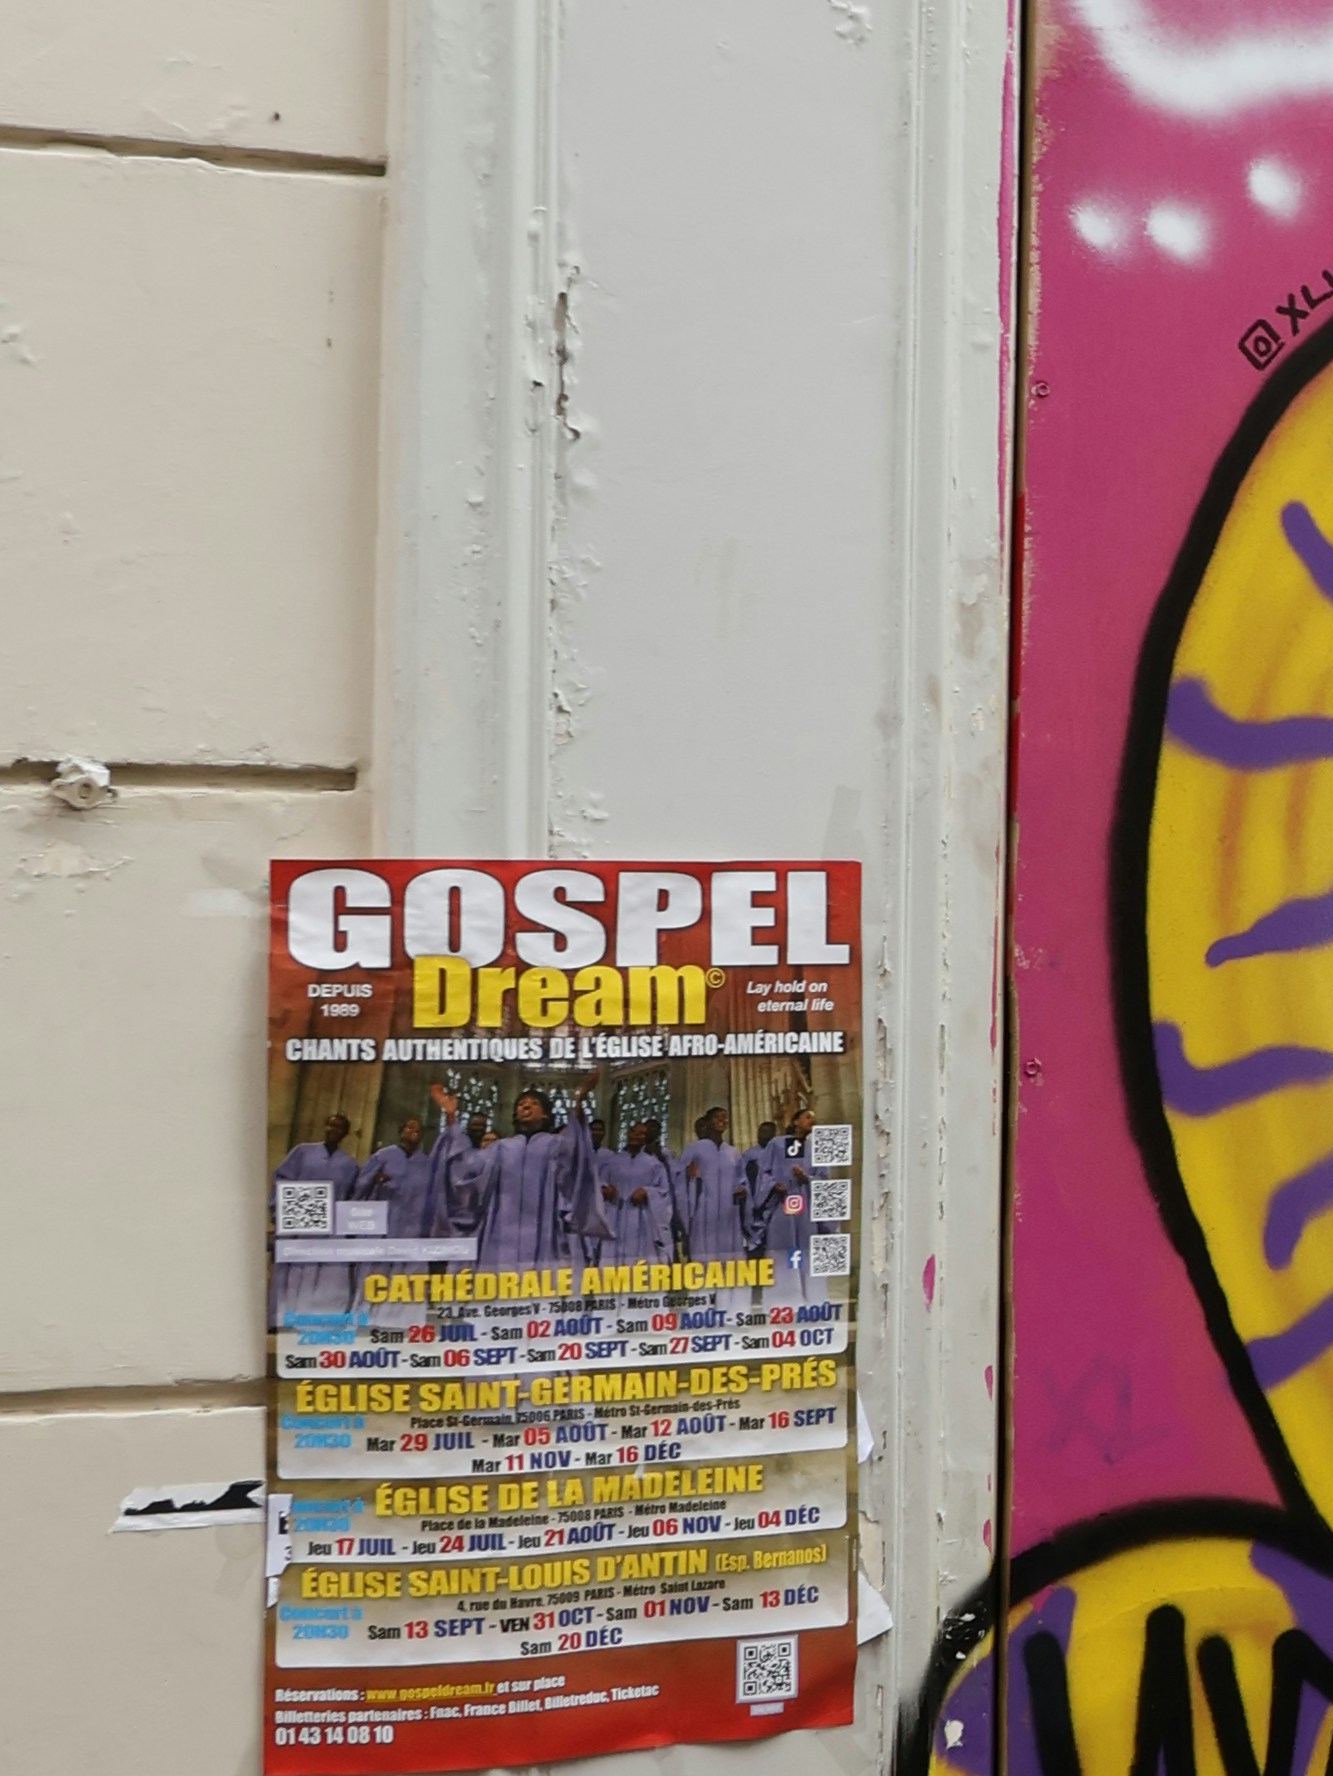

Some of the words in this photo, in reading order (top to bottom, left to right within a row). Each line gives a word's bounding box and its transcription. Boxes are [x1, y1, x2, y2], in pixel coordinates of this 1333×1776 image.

[287, 867, 851, 971] GOSPEL
[308, 984, 373, 997] DEPUIS
[747, 981, 769, 996] Lay
[774, 980, 805, 993] hold
[809, 982, 827, 993] on
[320, 1004, 360, 1016] 1989
[758, 999, 808, 1012] eternal
[811, 999, 834, 1011] life
[285, 1039, 376, 1061] CHANTS
[382, 1038, 542, 1062] AUTHENTIQUES
[549, 1037, 575, 1059] DE
[582, 1033, 663, 1058] L'ÉGLISE
[668, 1029, 844, 1056] AFRO-AMÉRICAINE
[363, 1267, 573, 1303] CATHÉDRALE
[581, 1259, 775, 1295] AMÉRICAINE
[371, 1329, 404, 1343] Sam
[408, 1325, 435, 1342] 26
[438, 1325, 478, 1342] JUIL
[491, 1327, 522, 1340] Sam
[527, 1321, 550, 1338] 02
[554, 1316, 604, 1336] AOÛT
[617, 1319, 648, 1333] Sam
[652, 1314, 677, 1331] 09
[680, 1308, 726, 1330] AOÛT
[736, 1311, 766, 1326] Sam
[770, 1307, 794, 1324] 23
[797, 1303, 842, 1323] AOÛT
[286, 1354, 317, 1369] Sam
[320, 1351, 346, 1368] 30
[350, 1348, 401, 1368] AOÛT
[410, 1354, 441, 1367] Sam
[444, 1351, 470, 1366] 06
[474, 1347, 517, 1365] SEPT
[527, 1348, 556, 1363] Sam
[557, 1343, 581, 1361] 20
[585, 1340, 628, 1359] SEPT
[639, 1342, 667, 1355] Sam
[670, 1337, 689, 1354] 27
[691, 1335, 732, 1353] SEPT
[742, 1336, 769, 1349] Sam
[772, 1331, 795, 1348] 04
[801, 1328, 834, 1346] OCT
[296, 1380, 411, 1413] ÉGLISE
[419, 1359, 837, 1413] SAINT-GERMAIN-DES-PRÉS
[367, 1438, 397, 1452] Mar
[400, 1434, 427, 1451] 29
[434, 1433, 474, 1451] JUIL
[493, 1434, 519, 1447] Mar
[524, 1427, 550, 1445] 05
[556, 1423, 608, 1443] AOÛT
[621, 1424, 647, 1439] Mar
[651, 1419, 671, 1437] 12
[676, 1414, 726, 1435] AOÛT
[739, 1416, 765, 1430] Mar
[768, 1411, 789, 1429] 16
[794, 1407, 837, 1427] SEPT
[472, 1459, 502, 1473] Mar
[505, 1455, 524, 1471] 11
[530, 1451, 572, 1470] NOV
[585, 1451, 612, 1465] Mar
[616, 1446, 638, 1463] 16
[644, 1442, 681, 1461] DÉC
[375, 1483, 489, 1516] ÉGLISE
[498, 1482, 538, 1510] DE
[546, 1479, 584, 1507] LA
[592, 1465, 763, 1503] MADELEINE
[308, 1541, 332, 1555] Jeu
[336, 1538, 354, 1555] 17
[357, 1538, 396, 1555] JUIL
[412, 1541, 436, 1554] Jeu
[439, 1535, 464, 1552] 24
[469, 1534, 506, 1551] JUIL
[518, 1534, 541, 1548] Jeu
[544, 1529, 565, 1546] 21
[567, 1522, 616, 1544] AOÛT
[627, 1524, 649, 1538] Jeu
[653, 1518, 678, 1536] 06
[683, 1516, 722, 1534] NOV
[734, 1517, 755, 1530] Jeu
[758, 1510, 781, 1528] 04
[785, 1506, 820, 1526] DÉC
[421, 1518, 454, 1532] Place
[457, 1517, 471, 1530] de
[475, 1517, 485, 1529] la
[488, 1513, 549, 1528] Madeleine
[594, 1507, 624, 1519] PARIS
[635, 1502, 666, 1516] Métro
[669, 1499, 726, 1513] Madeleine
[302, 1567, 402, 1599] ÉGLISE
[408, 1559, 590, 1598] SAINT-LOUIS
[597, 1549, 708, 1583] D'ANTIN
[753, 1544, 827, 1569] Bernanos)
[470, 1599, 489, 1611] rue
[492, 1597, 507, 1610] du
[584, 1588, 615, 1601] PARIS
[623, 1583, 655, 1596] Métro
[660, 1581, 689, 1594] Saint
[691, 1578, 725, 1592] Lazare
[368, 1625, 400, 1640] Sam
[404, 1621, 429, 1639] 13
[434, 1618, 485, 1637] SEPT
[500, 1618, 529, 1633] VEN
[533, 1612, 555, 1630] 31
[558, 1607, 595, 1627] OCT
[606, 1607, 637, 1621] Sam
[643, 1601, 665, 1618] 01
[669, 1596, 710, 1615] NOV
[722, 1597, 753, 1611] Sam
[760, 1590, 780, 1608] 13
[784, 1585, 819, 1606] DÉC
[520, 1641, 551, 1655] Sam
[557, 1632, 581, 1651] 20
[585, 1628, 623, 1647] DÉC
[464, 1700, 506, 1717] France
[611, 1684, 660, 1702] Ticketac
[497, 1679, 509, 1693] et
[512, 1679, 531, 1692] sur
[533, 1675, 565, 1691] place
[275, 1727, 296, 1745] 01
[298, 1727, 321, 1745] 43
[325, 1727, 344, 1745] 14
[347, 1726, 370, 1744] 08
[373, 1725, 394, 1744] 10
